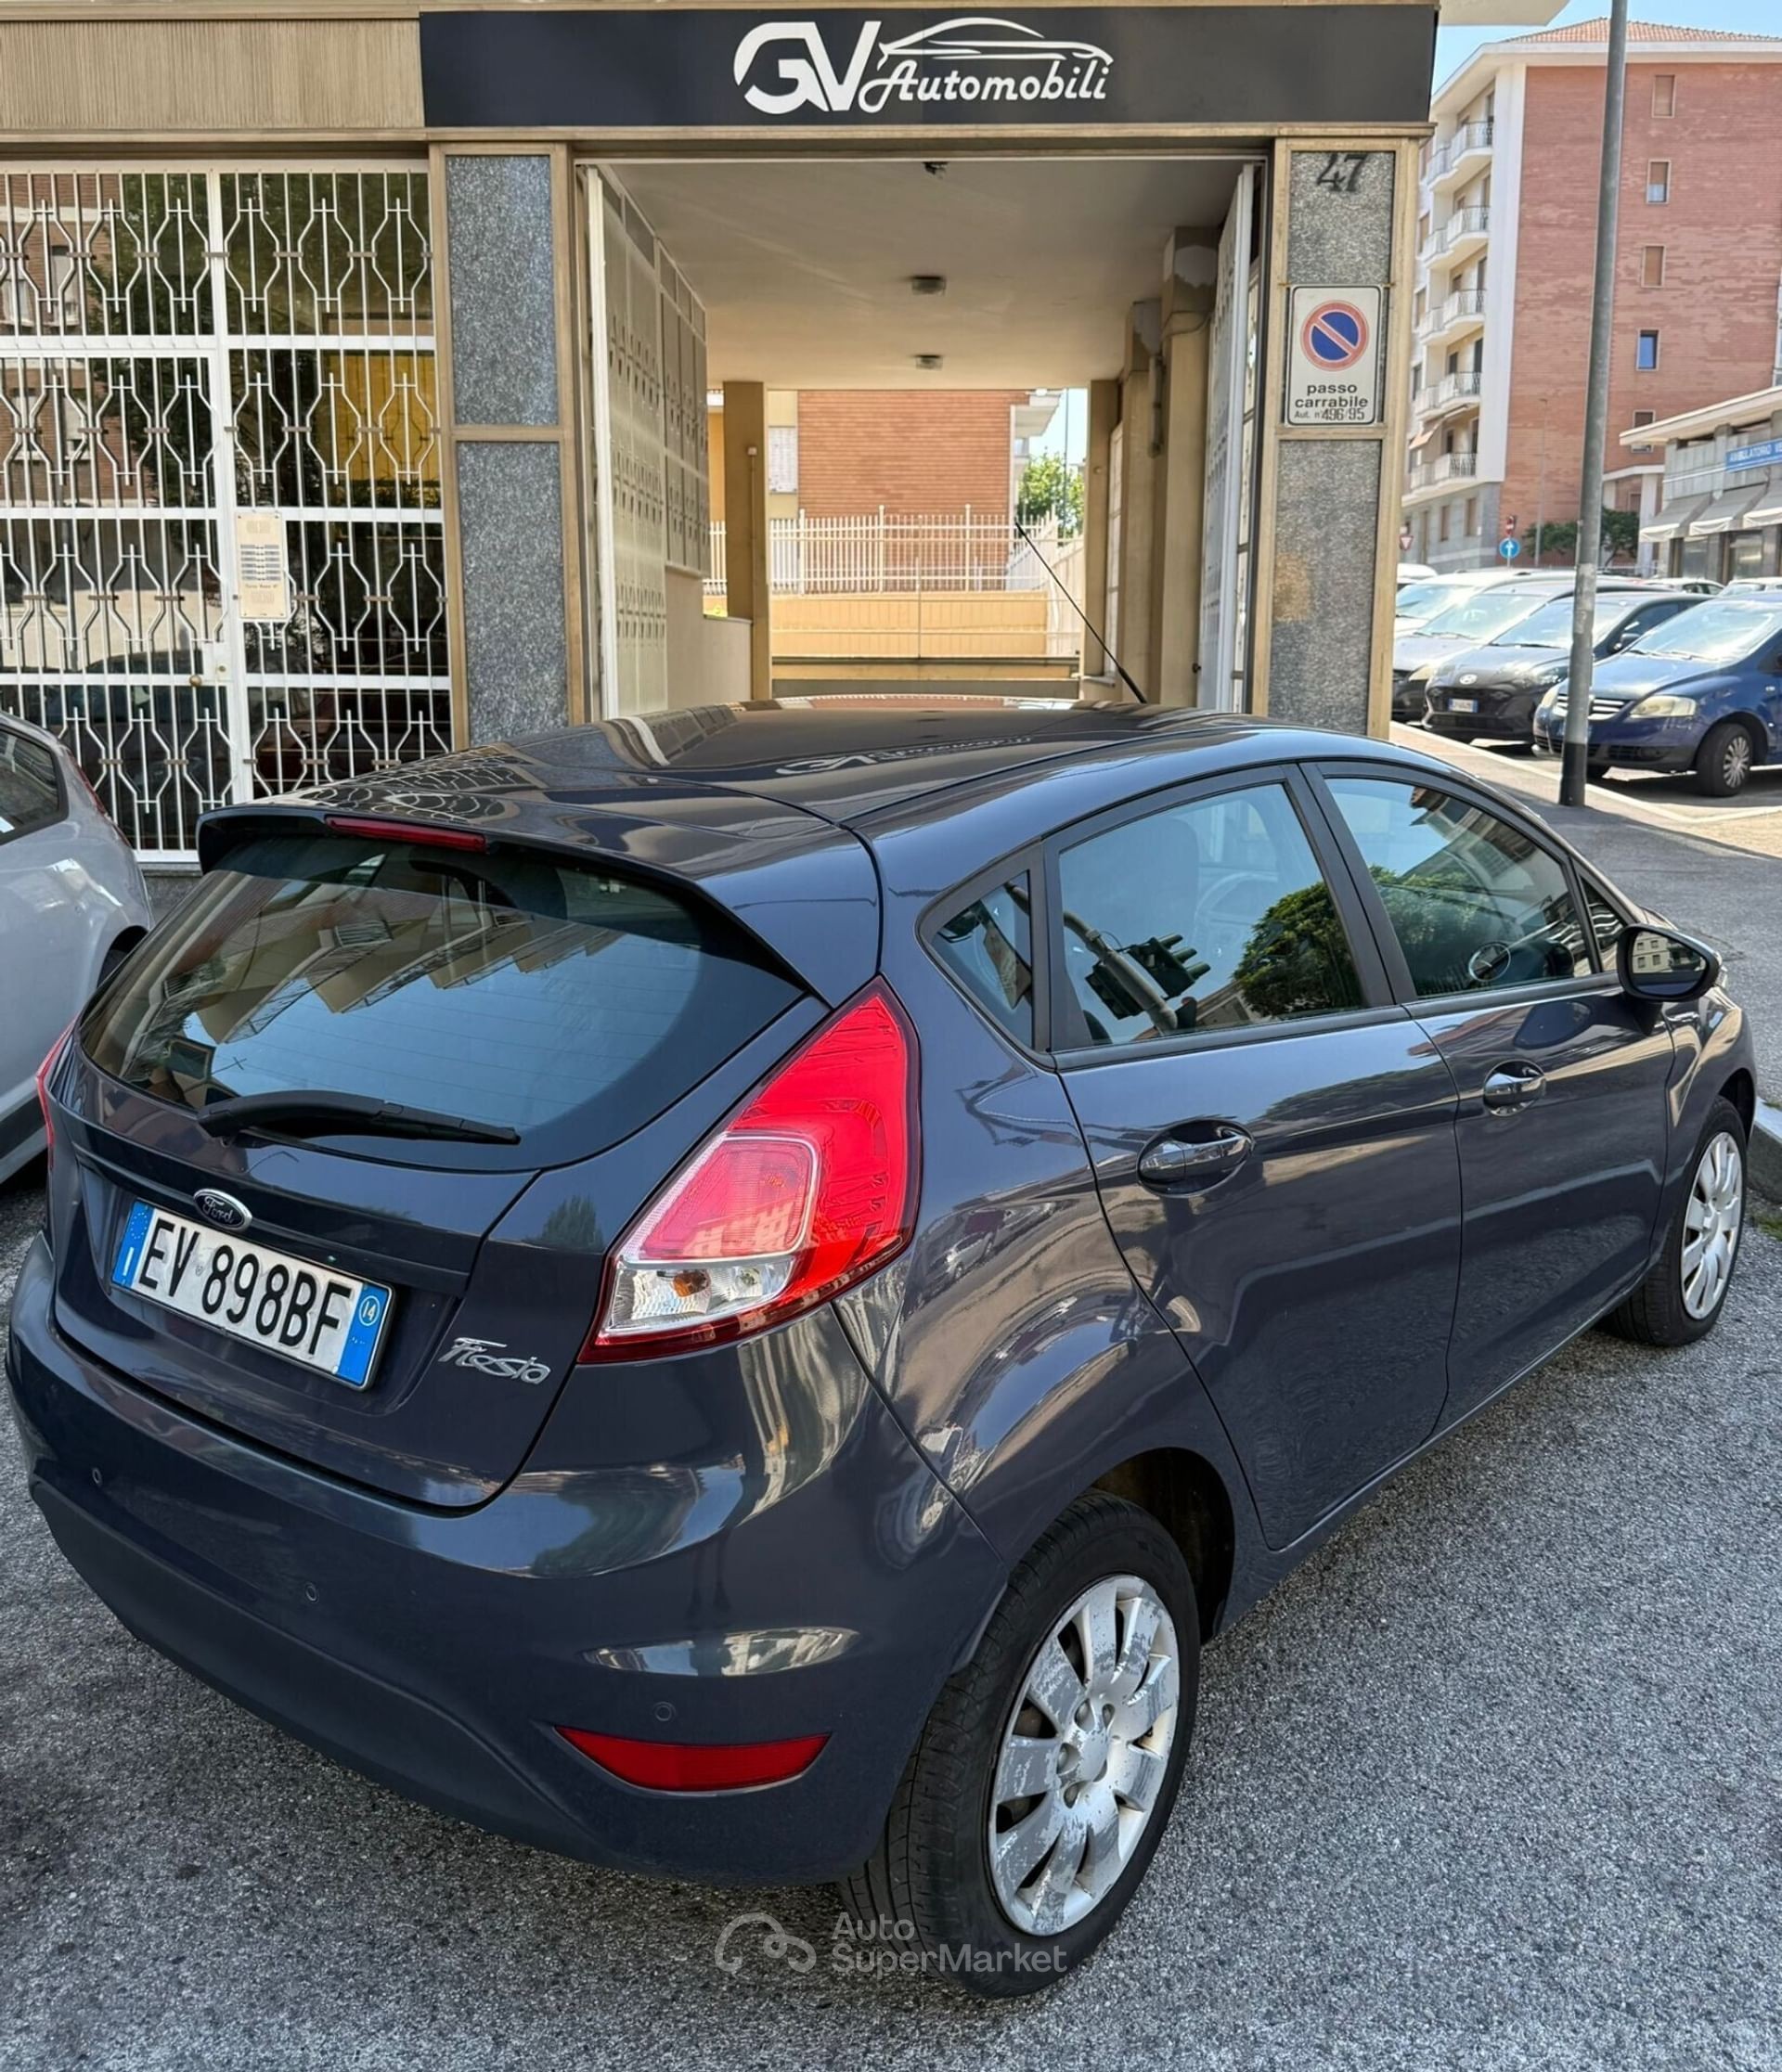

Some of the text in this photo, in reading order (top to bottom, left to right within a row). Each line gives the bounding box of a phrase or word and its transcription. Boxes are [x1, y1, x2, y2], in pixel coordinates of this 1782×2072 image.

[733, 20, 1110, 114] GV Automobili
[1316, 153, 1368, 192] 47
[1295, 396, 1368, 408] carrabile
[1307, 383, 1358, 396] passo
[202, 1195, 234, 1223] Ford
[138, 1217, 353, 1356] EV 898BF
[362, 1300, 377, 1322] 14
[437, 1336, 551, 1384] Fiesta
